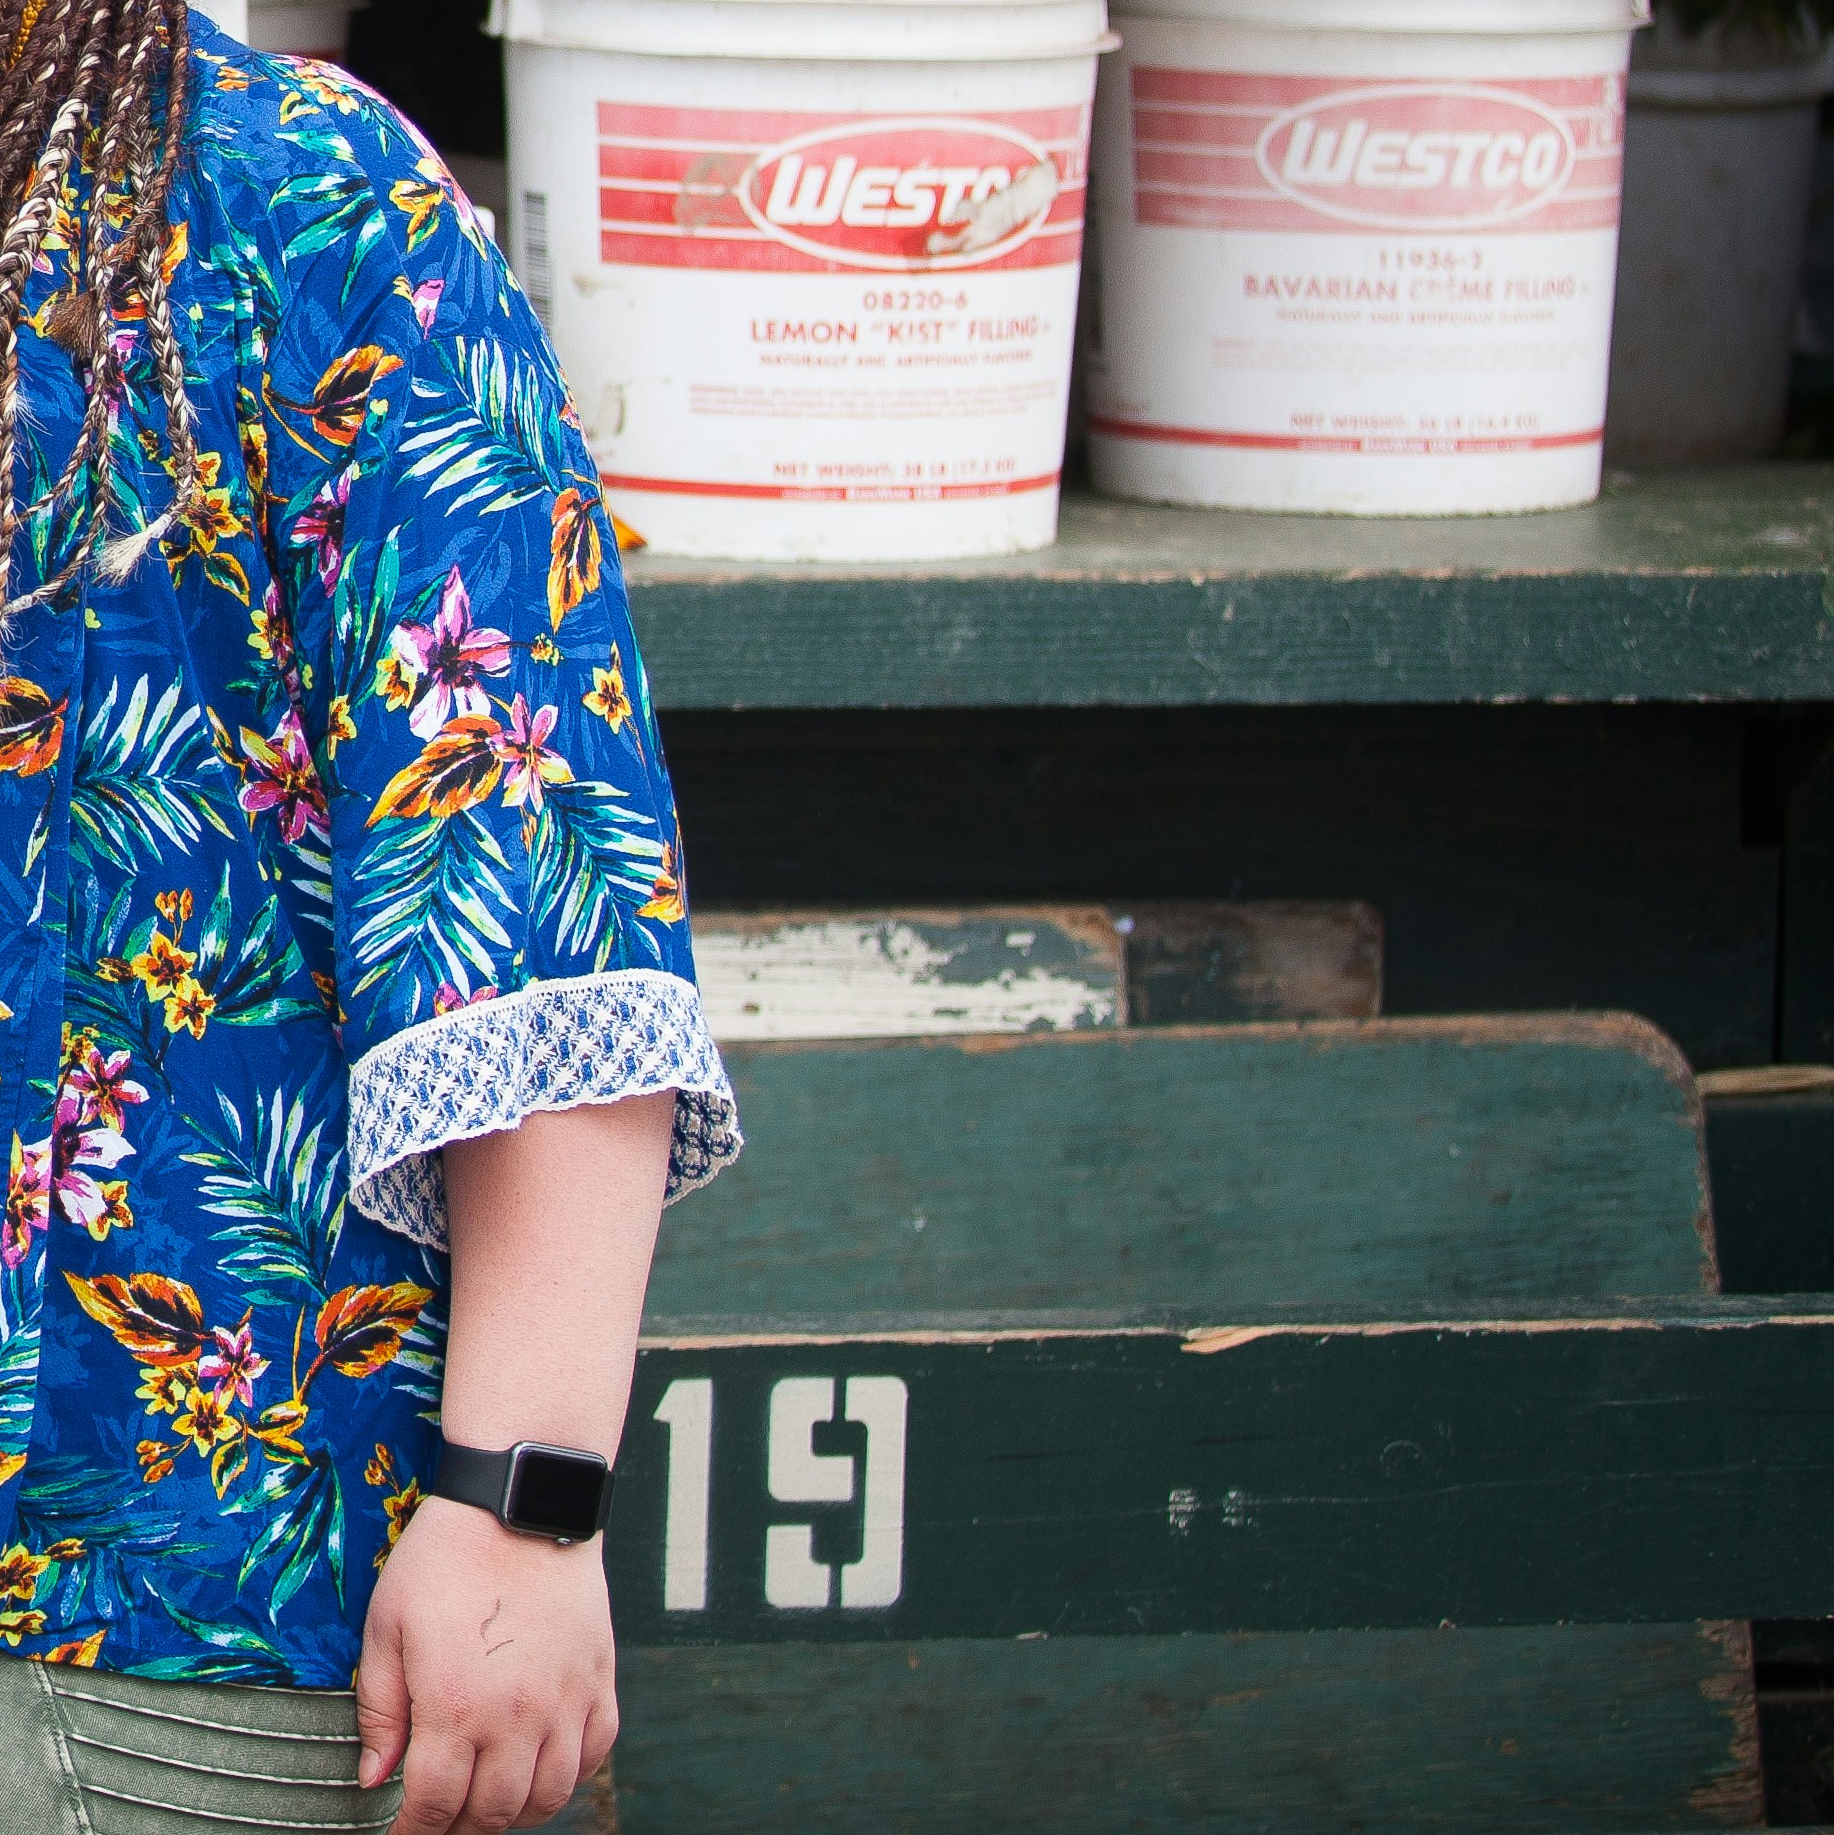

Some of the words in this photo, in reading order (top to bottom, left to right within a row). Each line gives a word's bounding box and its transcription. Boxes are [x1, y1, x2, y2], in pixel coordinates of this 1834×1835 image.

[1282, 118, 1560, 188] WESTCO
[765, 154, 1033, 228] WEST
[1243, 274, 1398, 302] BAVARIAN
[750, 319, 858, 343] LEMON
[653, 1376, 909, 1611] 19
